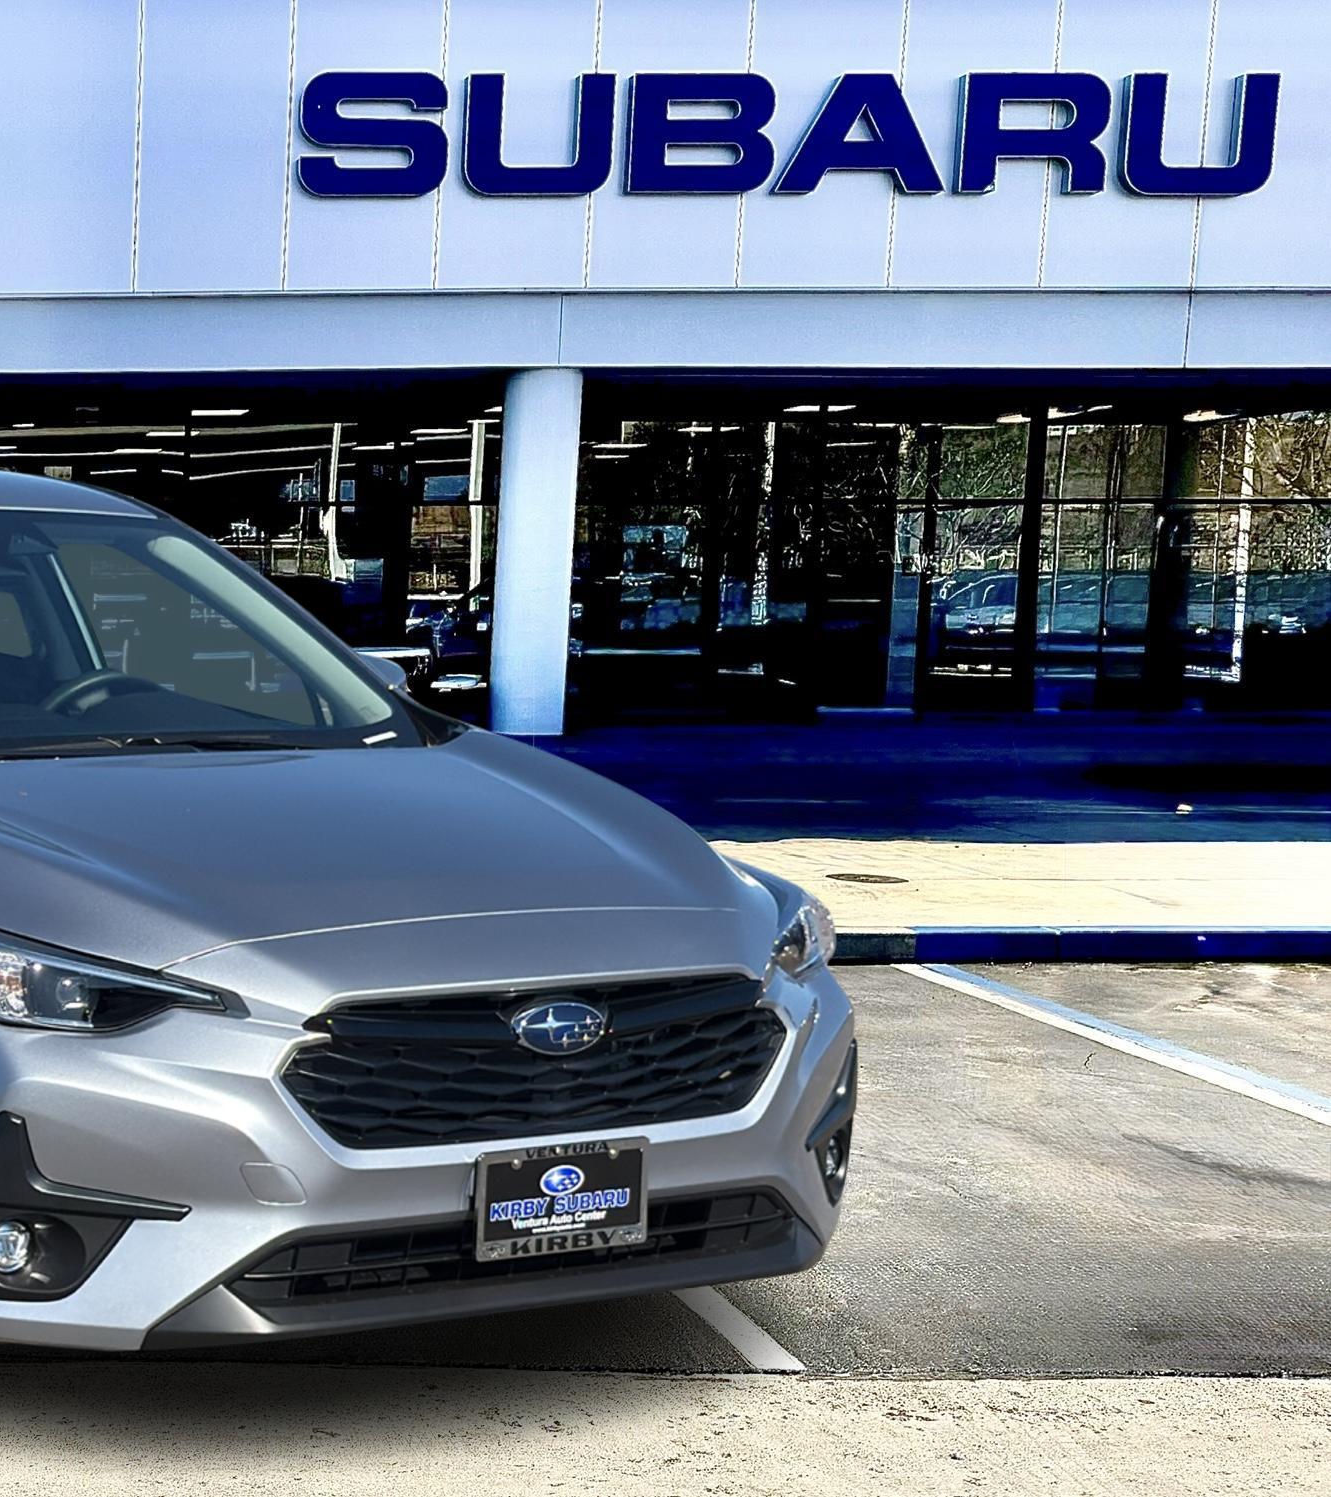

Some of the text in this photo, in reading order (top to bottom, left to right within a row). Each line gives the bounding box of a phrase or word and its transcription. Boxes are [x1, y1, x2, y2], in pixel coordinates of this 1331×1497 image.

[297, 72, 1281, 199] SUBARU
[525, 1141, 609, 1159] VENTURA
[490, 1188, 630, 1221] KIRBY SUBARU
[512, 1217, 548, 1230] Ventura
[550, 1214, 573, 1225] Auto
[574, 1210, 607, 1222] Center
[510, 1230, 616, 1256] KIRBY
